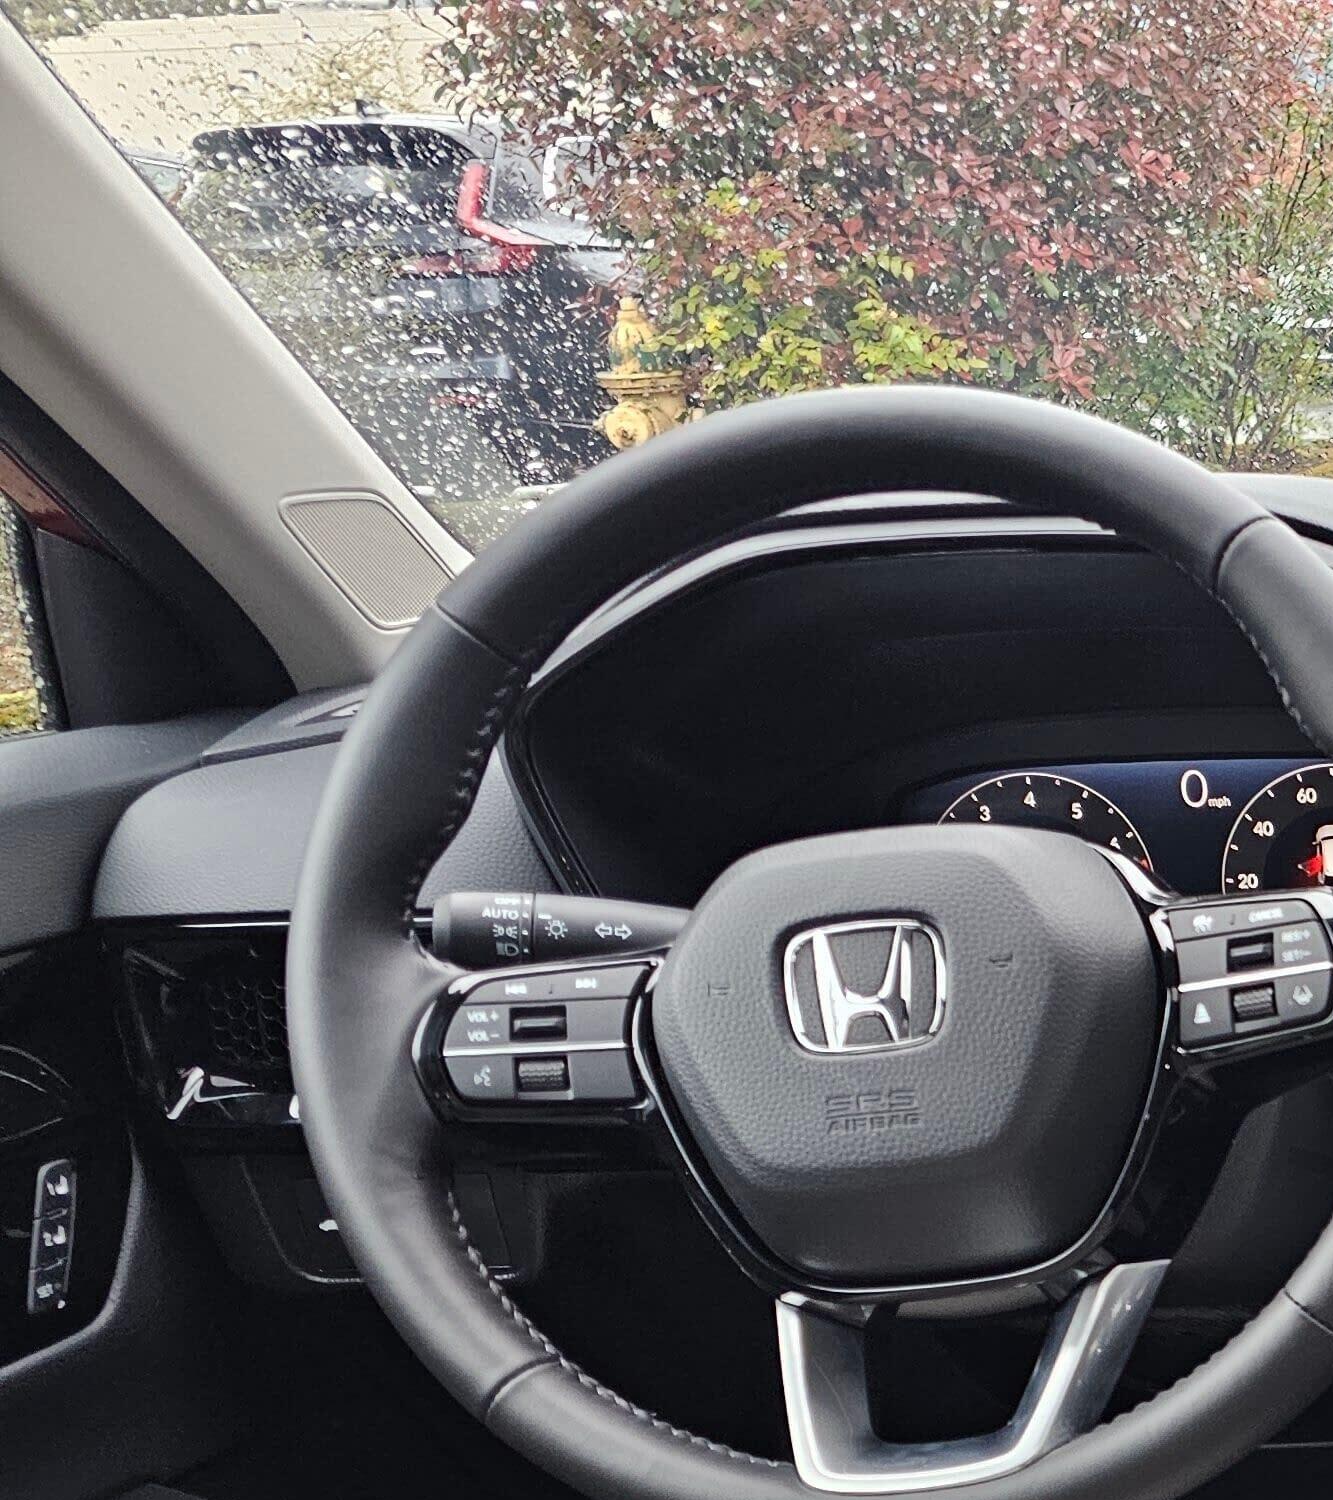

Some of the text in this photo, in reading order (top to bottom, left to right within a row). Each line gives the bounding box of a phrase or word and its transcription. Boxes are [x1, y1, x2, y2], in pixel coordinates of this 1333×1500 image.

[1180, 768, 1232, 809] 0 mph
[1296, 787, 1318, 804] 60
[1023, 790, 1039, 808] 4
[979, 804, 992, 822] 3
[1071, 802, 1084, 821] 5
[1253, 820, 1275, 838] 40
[1237, 873, 1259, 890] 20
[482, 906, 519, 921] AUTO
